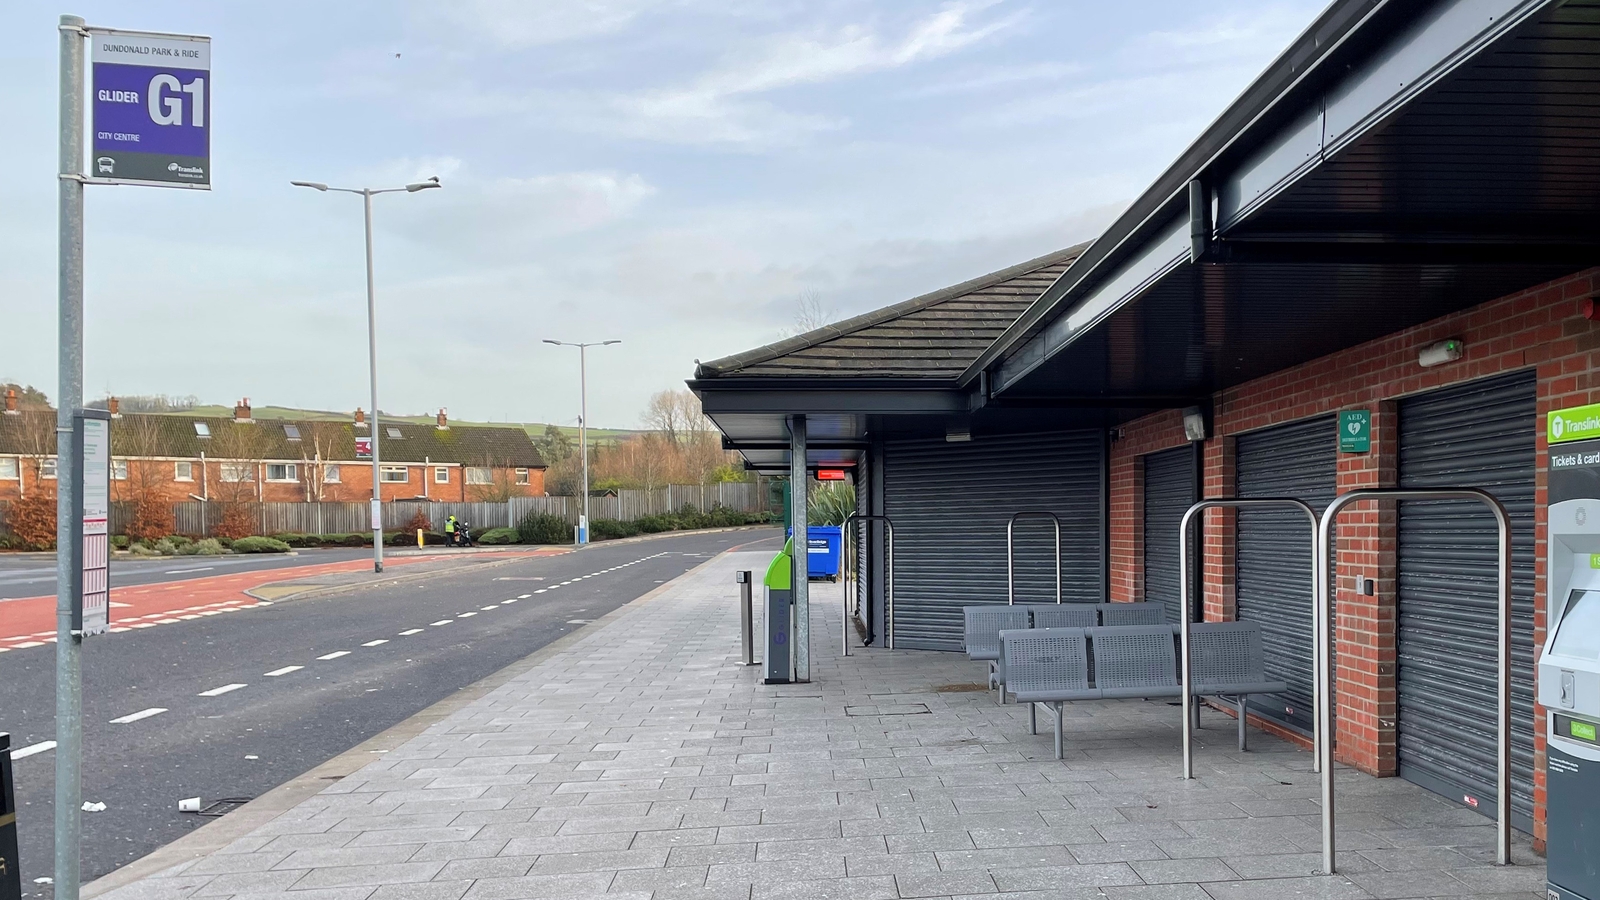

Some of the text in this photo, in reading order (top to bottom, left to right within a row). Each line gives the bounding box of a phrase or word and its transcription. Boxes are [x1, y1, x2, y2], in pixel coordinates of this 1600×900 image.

[103, 44, 199, 58] DUNDONALD PARK & RIDE
[98, 73, 204, 128] GLIDER G1
[98, 132, 140, 142] CITY CENTRE
[1552, 455, 1576, 467] Tickets
[1577, 453, 1582, 464] &
